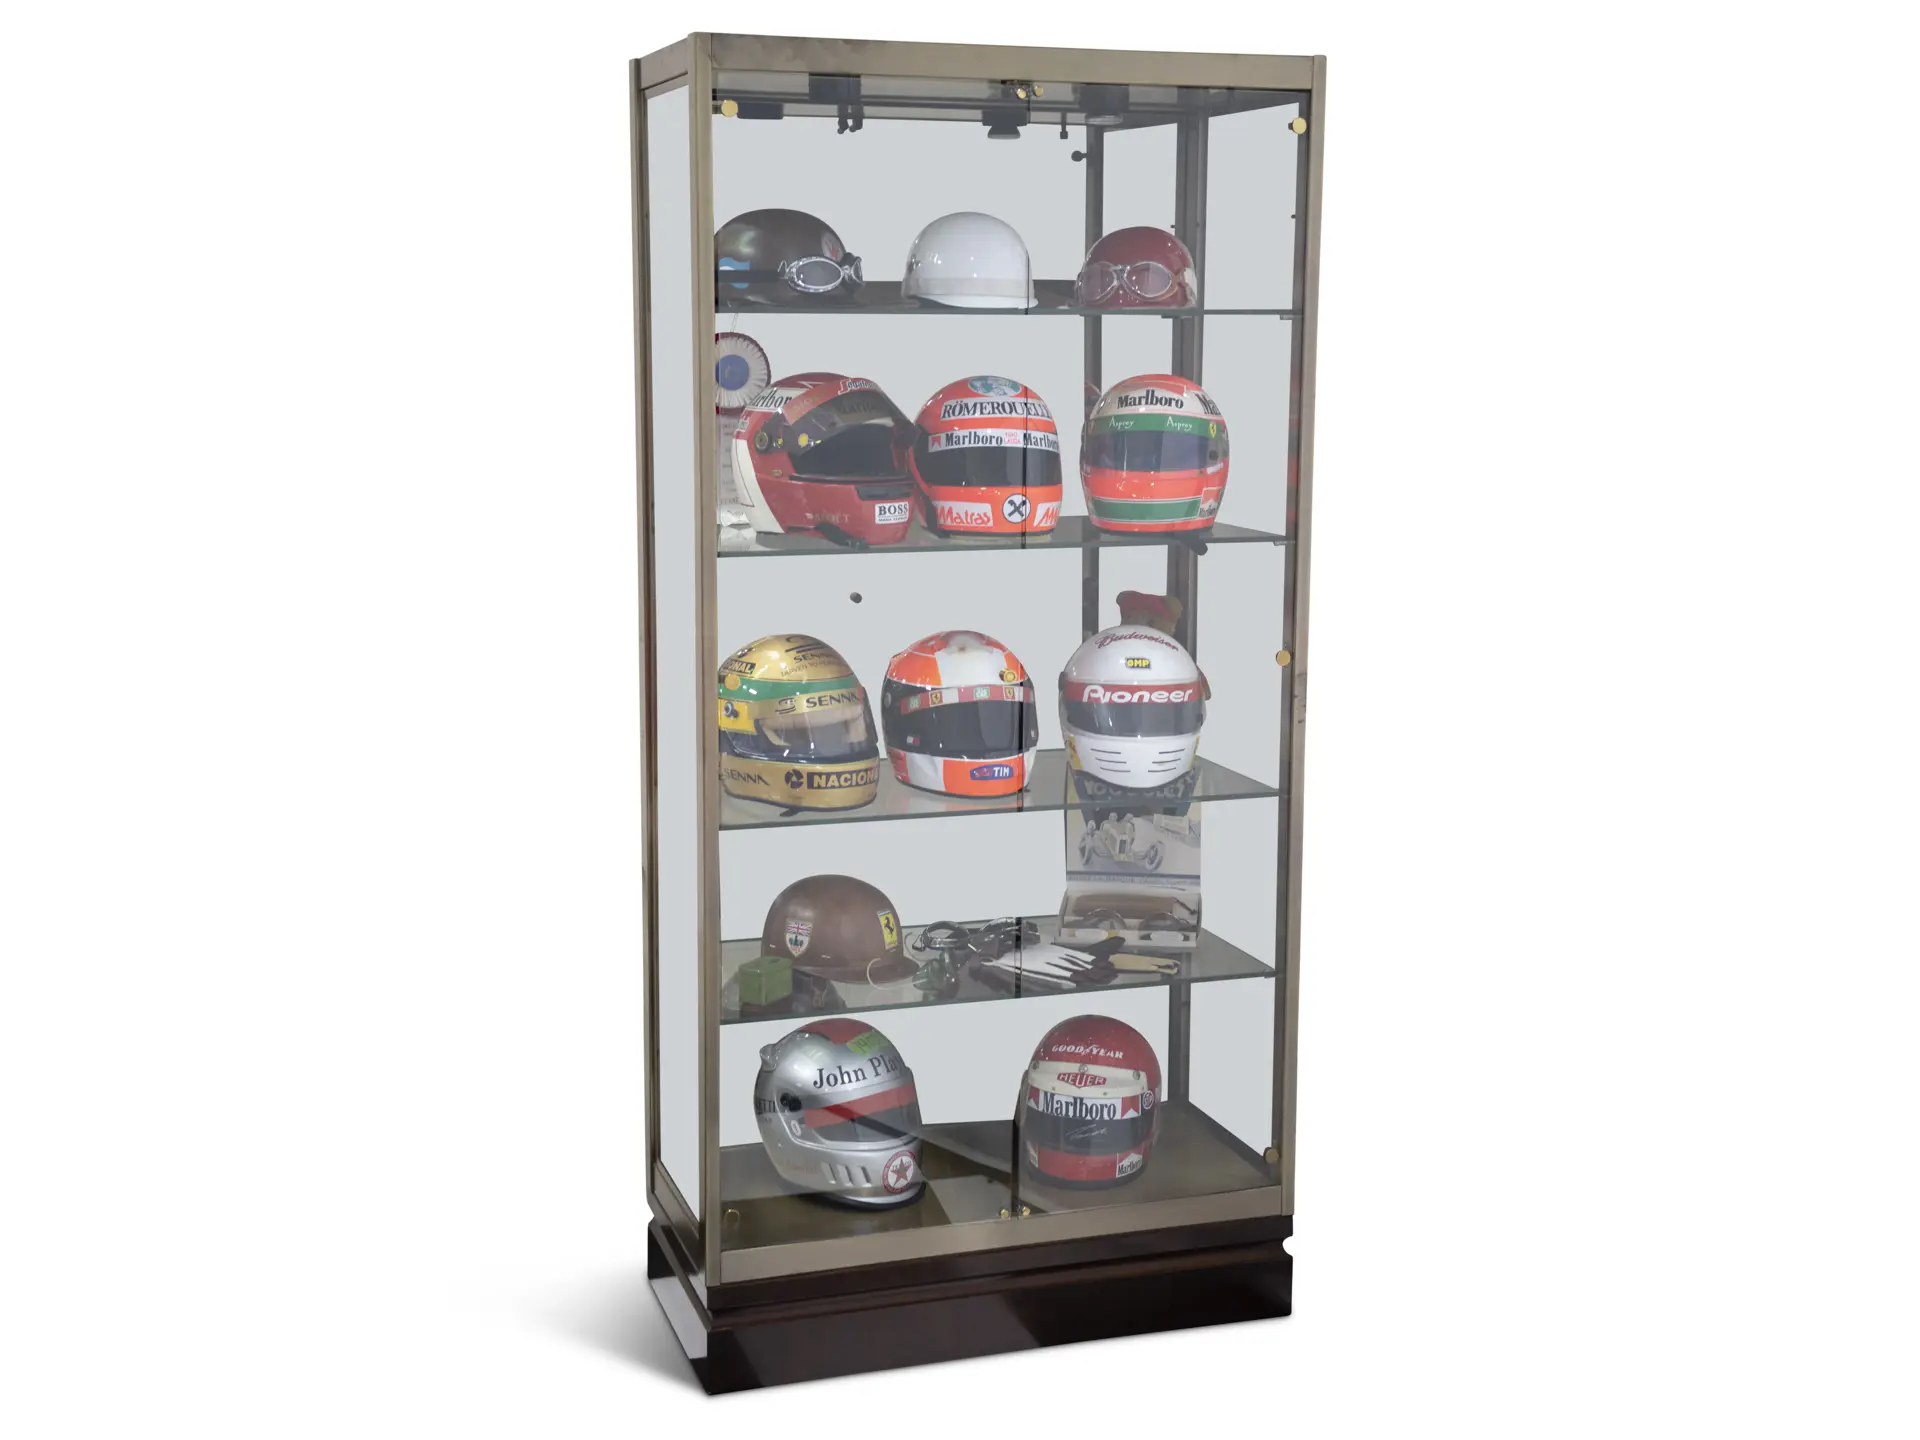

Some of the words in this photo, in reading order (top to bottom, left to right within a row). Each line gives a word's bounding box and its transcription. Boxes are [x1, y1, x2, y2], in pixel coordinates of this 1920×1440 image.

[1117, 389, 1184, 409] Marlboro
[1167, 416, 1193, 431] Asprey
[945, 431, 1003, 448] Marlboro
[878, 503, 908, 516] BOSS
[936, 505, 991, 526] Matras
[1095, 632, 1178, 651] Budweiser
[1127, 659, 1150, 668] OMP
[1082, 685, 1192, 703] Pioneer
[993, 766, 1010, 777] TIM
[813, 1066, 867, 1089] John
[1059, 1073, 1105, 1087] HEUER
[1042, 1091, 1117, 1119] Marlboro
